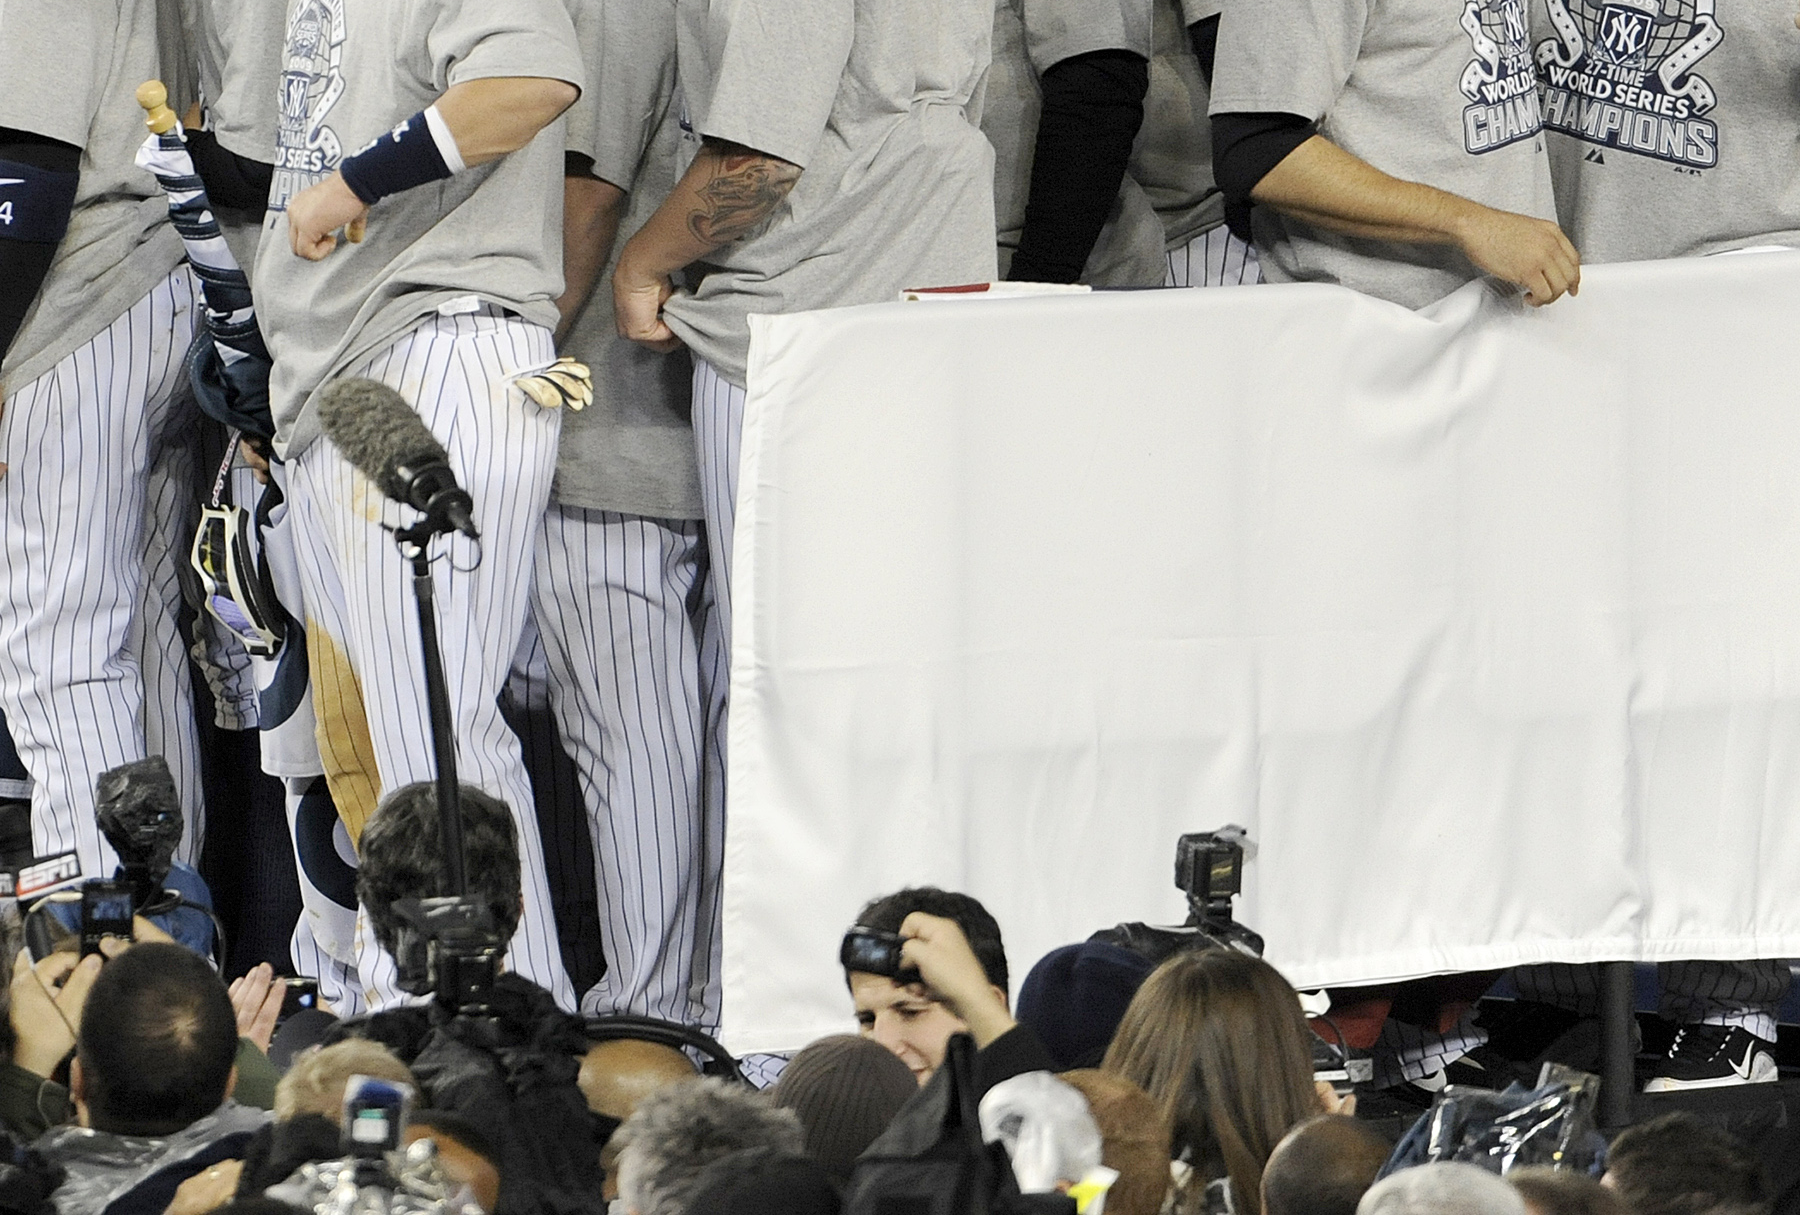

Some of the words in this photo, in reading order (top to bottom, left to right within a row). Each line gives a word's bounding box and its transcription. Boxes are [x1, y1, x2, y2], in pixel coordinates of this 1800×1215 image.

[1605, 12, 1643, 56] NY
[1481, 72, 1531, 104] WORLD
[1550, 66, 1612, 99] WORLD
[1613, 84, 1691, 120] SERIES
[1584, 59, 1647, 88] 27-TIME
[18, 853, 79, 892] ESPN
